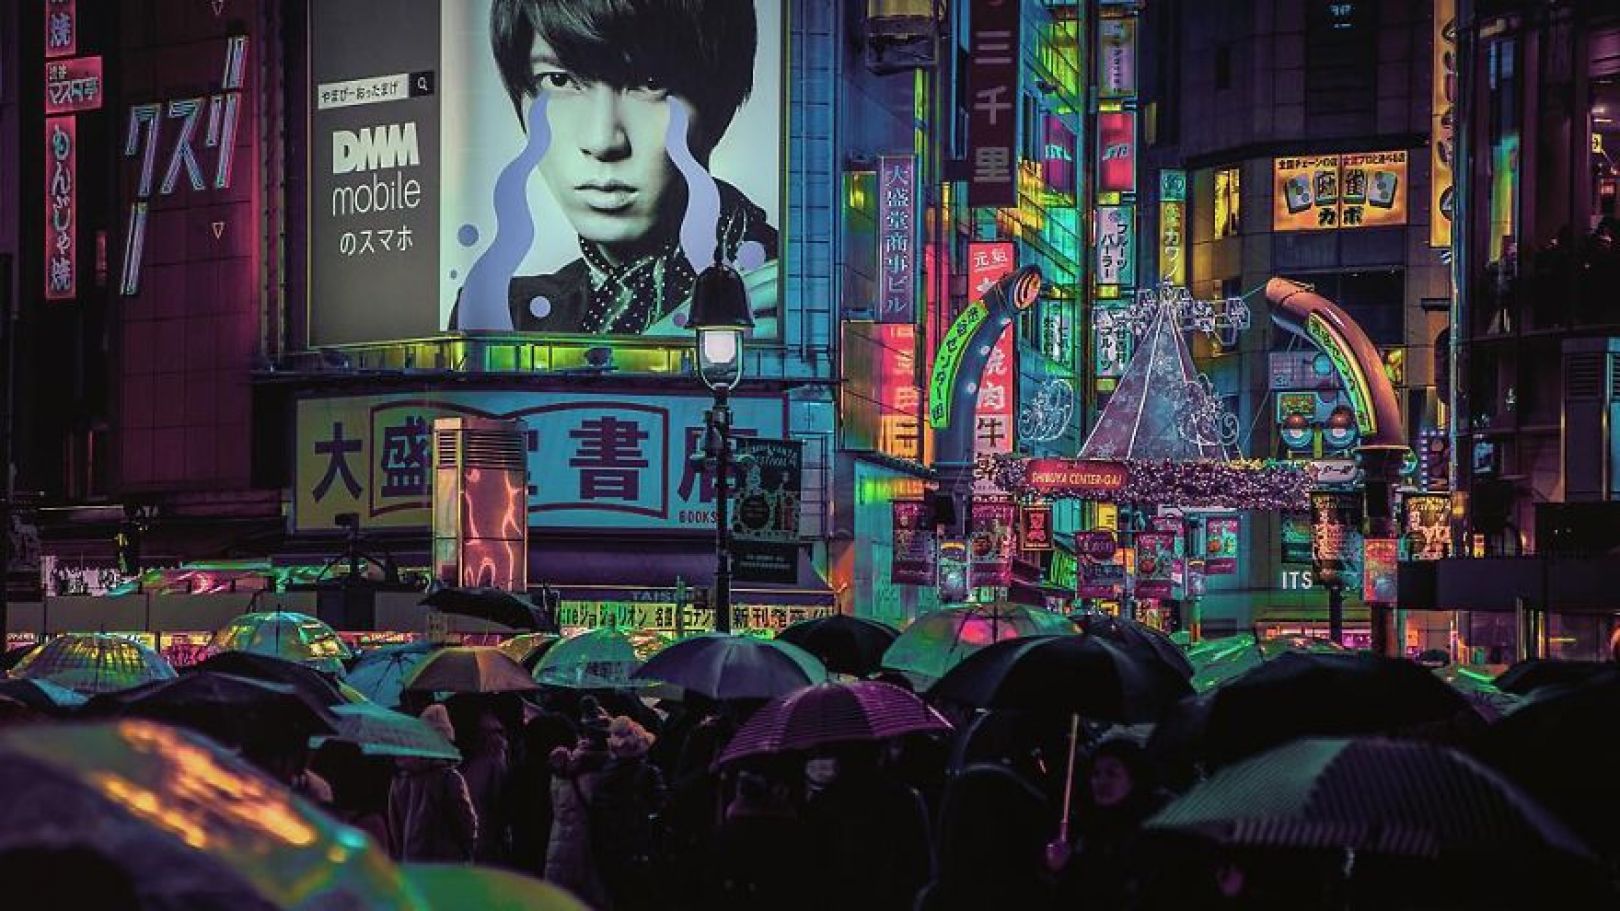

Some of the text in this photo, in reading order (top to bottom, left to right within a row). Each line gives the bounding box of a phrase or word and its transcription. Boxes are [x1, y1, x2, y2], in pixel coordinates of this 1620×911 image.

[974, 0, 1013, 184] 三千里
[332, 121, 421, 175] DMM
[332, 171, 421, 217] mobile
[339, 224, 413, 257] のスマホ
[884, 164, 909, 313] 大盛堂商事ビル
[312, 415, 758, 503] 大盛書店
[1032, 471, 1067, 484] SHIBUYA
[678, 509, 718, 524] BOOKS
[1282, 571, 1313, 590] ITS
